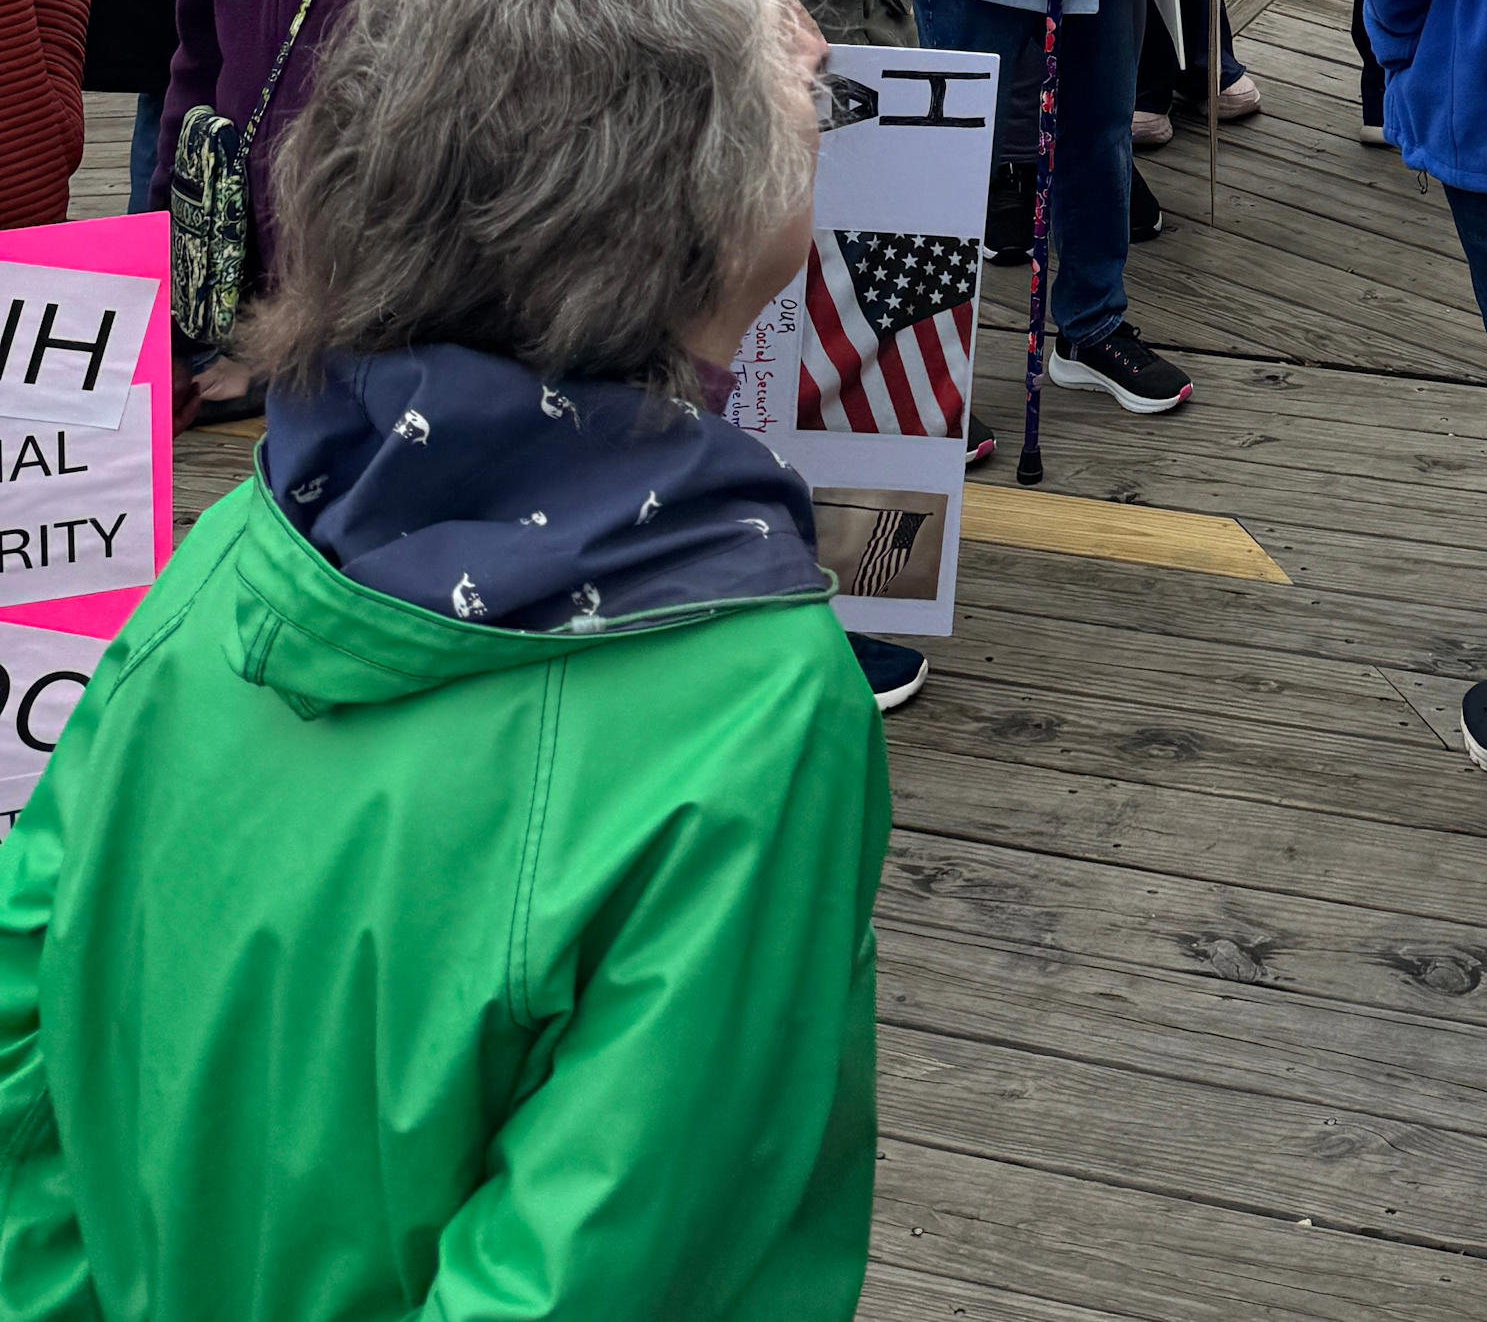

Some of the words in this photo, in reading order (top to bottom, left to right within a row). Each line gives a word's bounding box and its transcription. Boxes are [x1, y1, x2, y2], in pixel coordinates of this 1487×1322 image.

[777, 298, 798, 334] OUR
[753, 321, 777, 364] Social
[741, 370, 778, 434] Security
[0, 513, 127, 573] RITY
